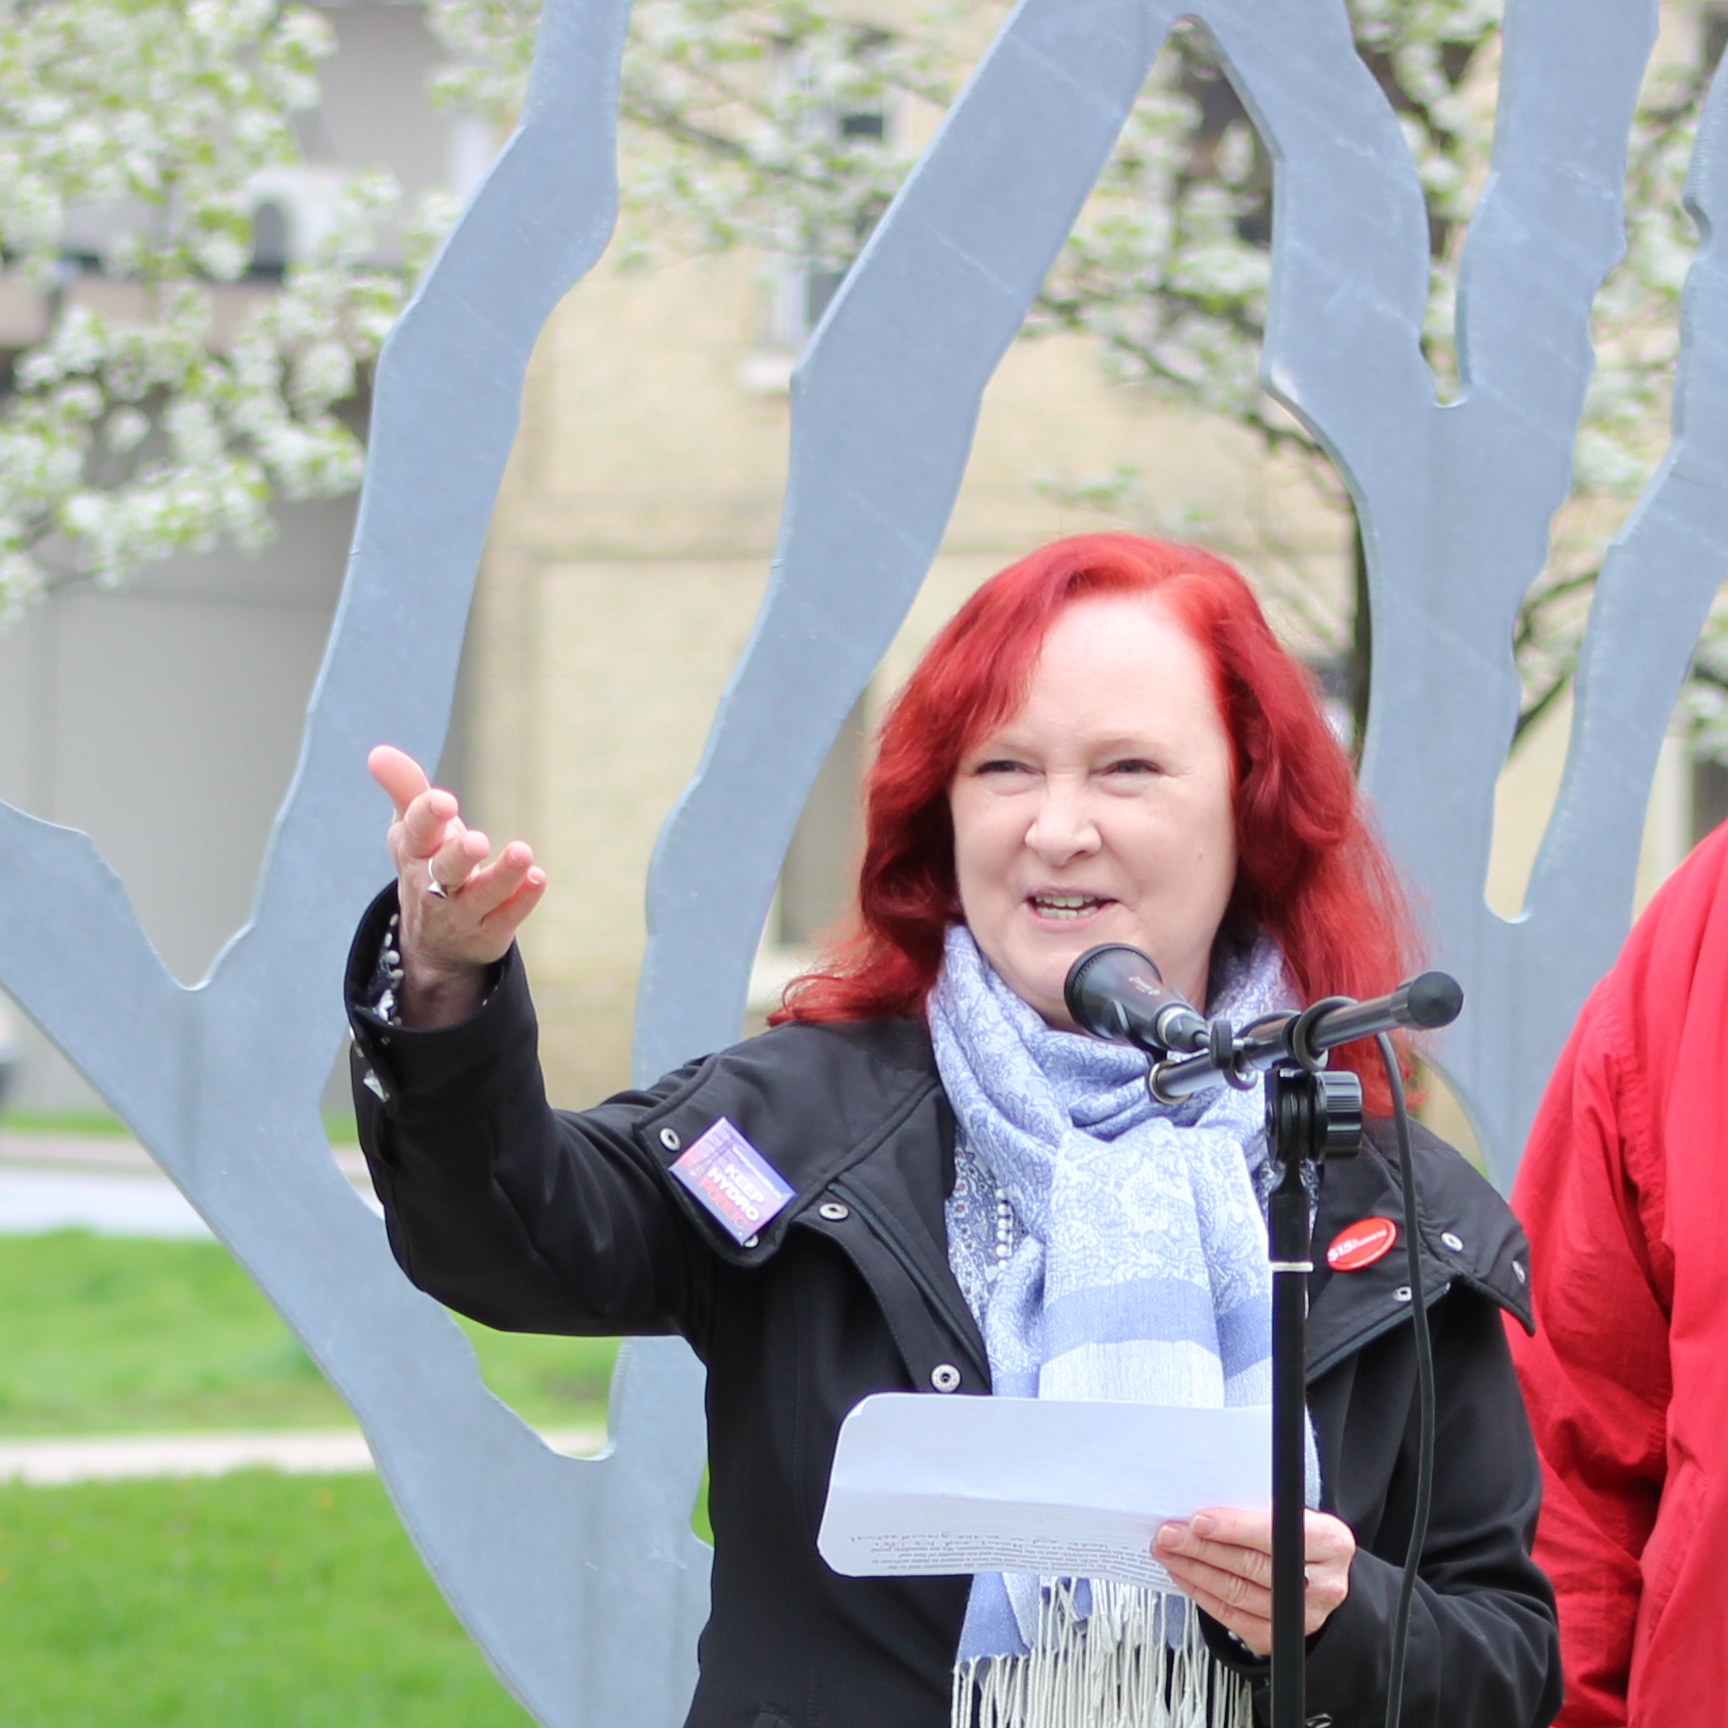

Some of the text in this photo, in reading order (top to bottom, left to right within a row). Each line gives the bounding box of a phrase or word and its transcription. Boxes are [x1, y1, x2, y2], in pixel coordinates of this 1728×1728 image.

[699, 1177, 747, 1229] PUBLIC
[707, 1166, 760, 1222] HYDRO
[724, 1163, 765, 1203] KEEP
